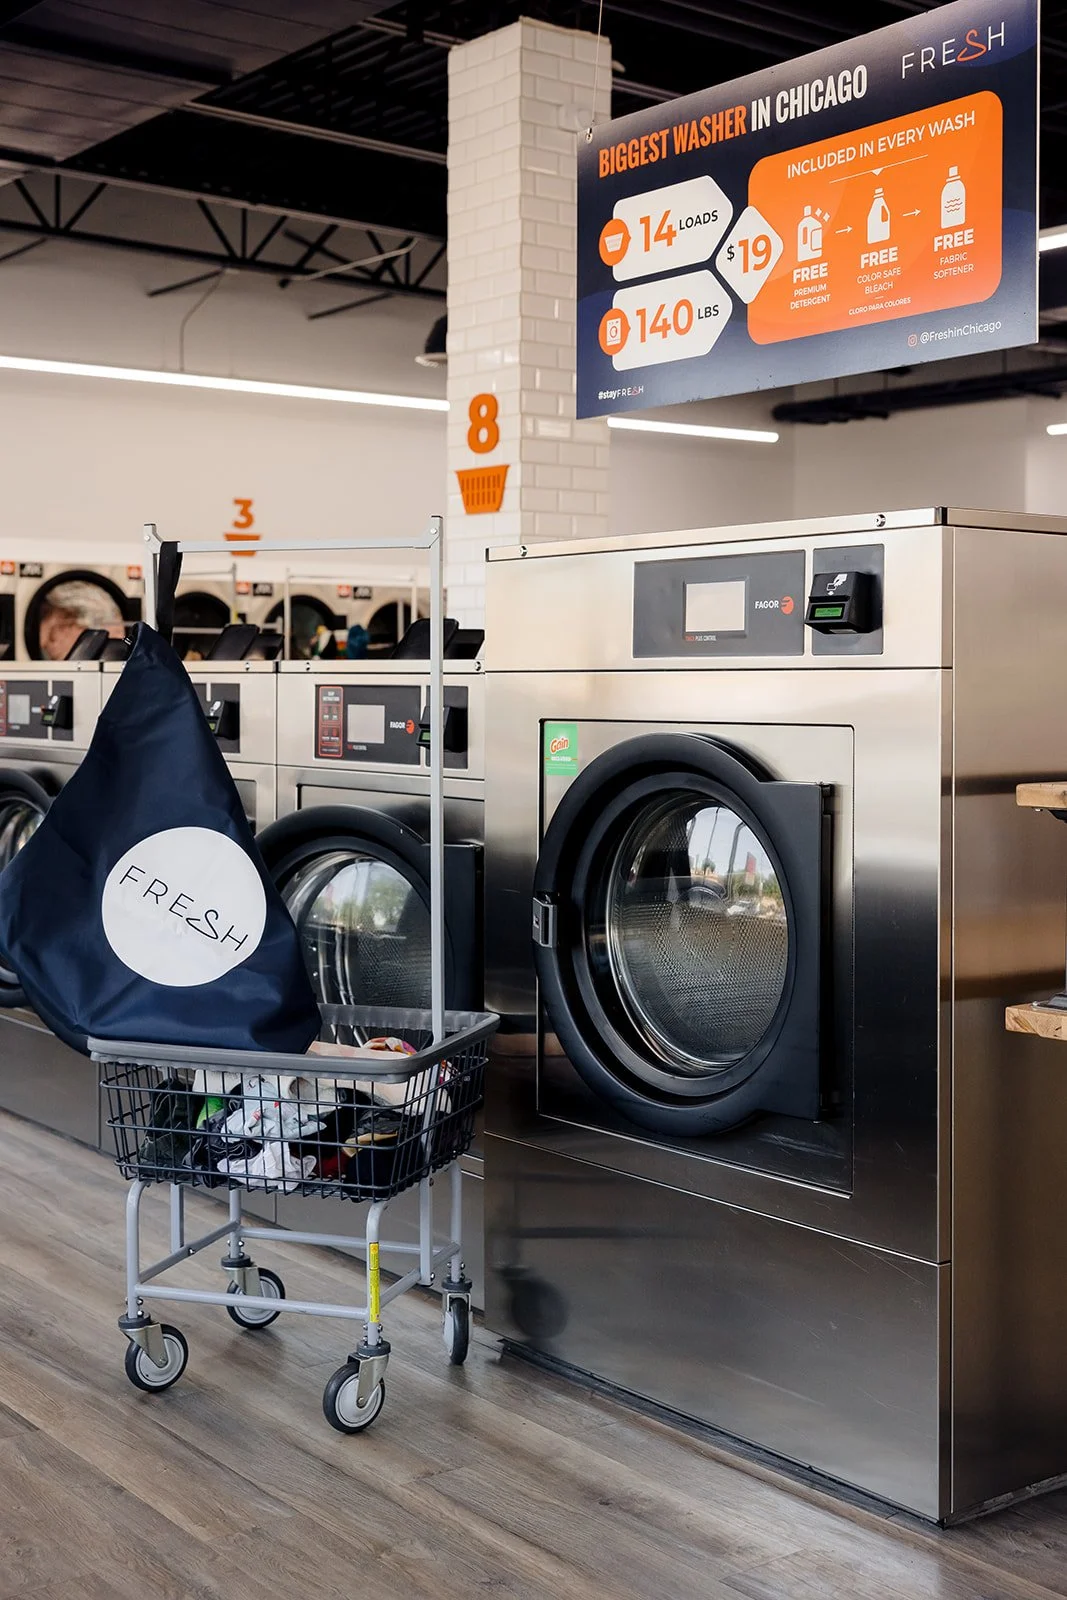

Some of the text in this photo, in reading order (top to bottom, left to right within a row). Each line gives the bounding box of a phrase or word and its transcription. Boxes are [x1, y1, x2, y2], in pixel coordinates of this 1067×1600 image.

[901, 22, 1005, 79] FRESH
[598, 64, 868, 179] BIGGEST WASHER IN CHICAGO
[787, 110, 976, 179] INCLUDED IN EVERY WASH
[639, 209, 719, 252] 14 LOADS
[933, 228, 975, 252] FREE
[860, 246, 899, 269] FREE
[939, 252, 968, 266] FABRIC
[793, 262, 829, 284] FREE
[857, 266, 902, 285] COLOR SAFE
[933, 264, 975, 280] SOFTENER
[794, 283, 827, 297] PREMIUM
[864, 281, 894, 295] BLEACH
[790, 294, 831, 310] DETERGENT
[848, 297, 911, 316] CLORO PARA COLORES
[636, 299, 720, 343] 140 LBS
[920, 321, 1002, 344] @FreshinChicago
[467, 394, 500, 453] 8
[232, 498, 254, 529] 3
[754, 600, 779, 609] FAGOR
[389, 721, 406, 729] FAGOR
[550, 737, 570, 754] Gain
[119, 865, 249, 951] FRESH
